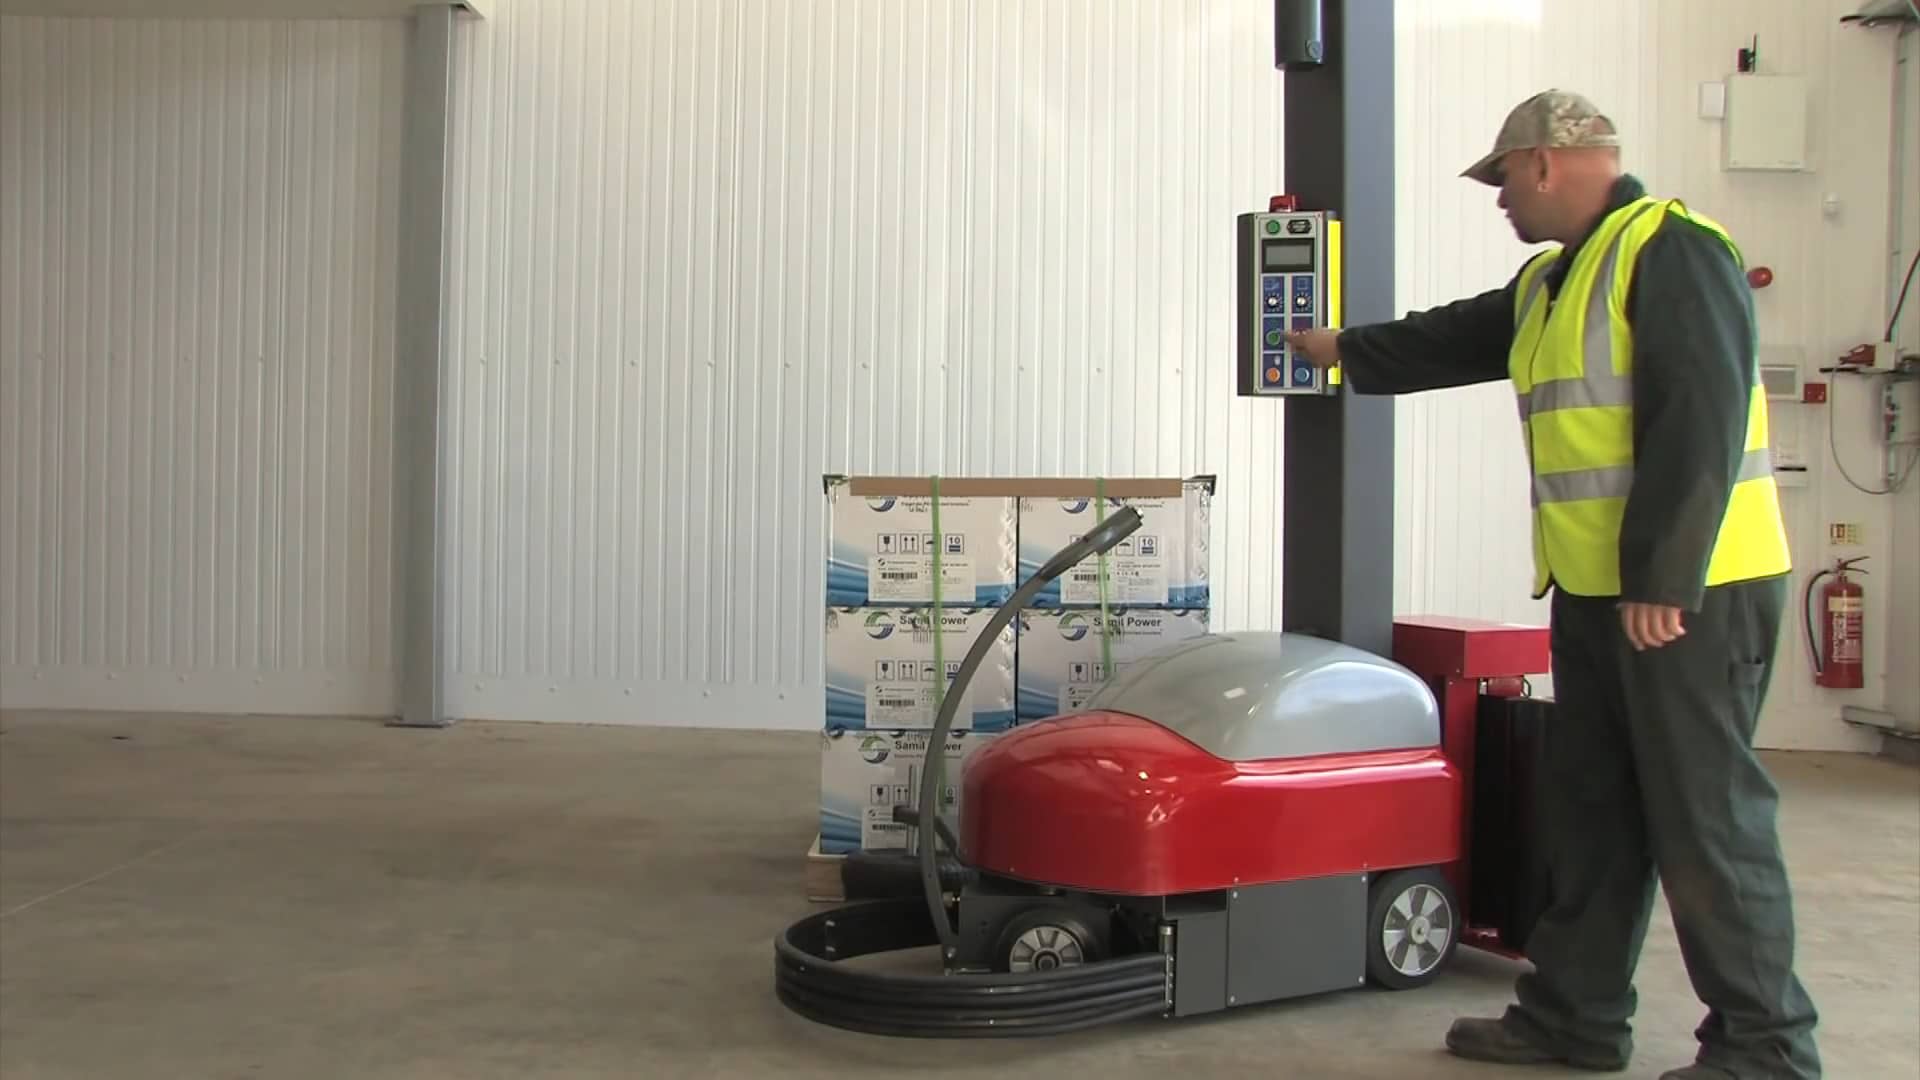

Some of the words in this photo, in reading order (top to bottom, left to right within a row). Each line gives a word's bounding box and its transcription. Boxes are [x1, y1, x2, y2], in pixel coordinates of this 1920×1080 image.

[949, 537, 961, 545] 10
[1141, 538, 1154, 546] 10
[1127, 617, 1162, 627] Power
[946, 664, 959, 672] 10
[895, 740, 926, 751] Samil
